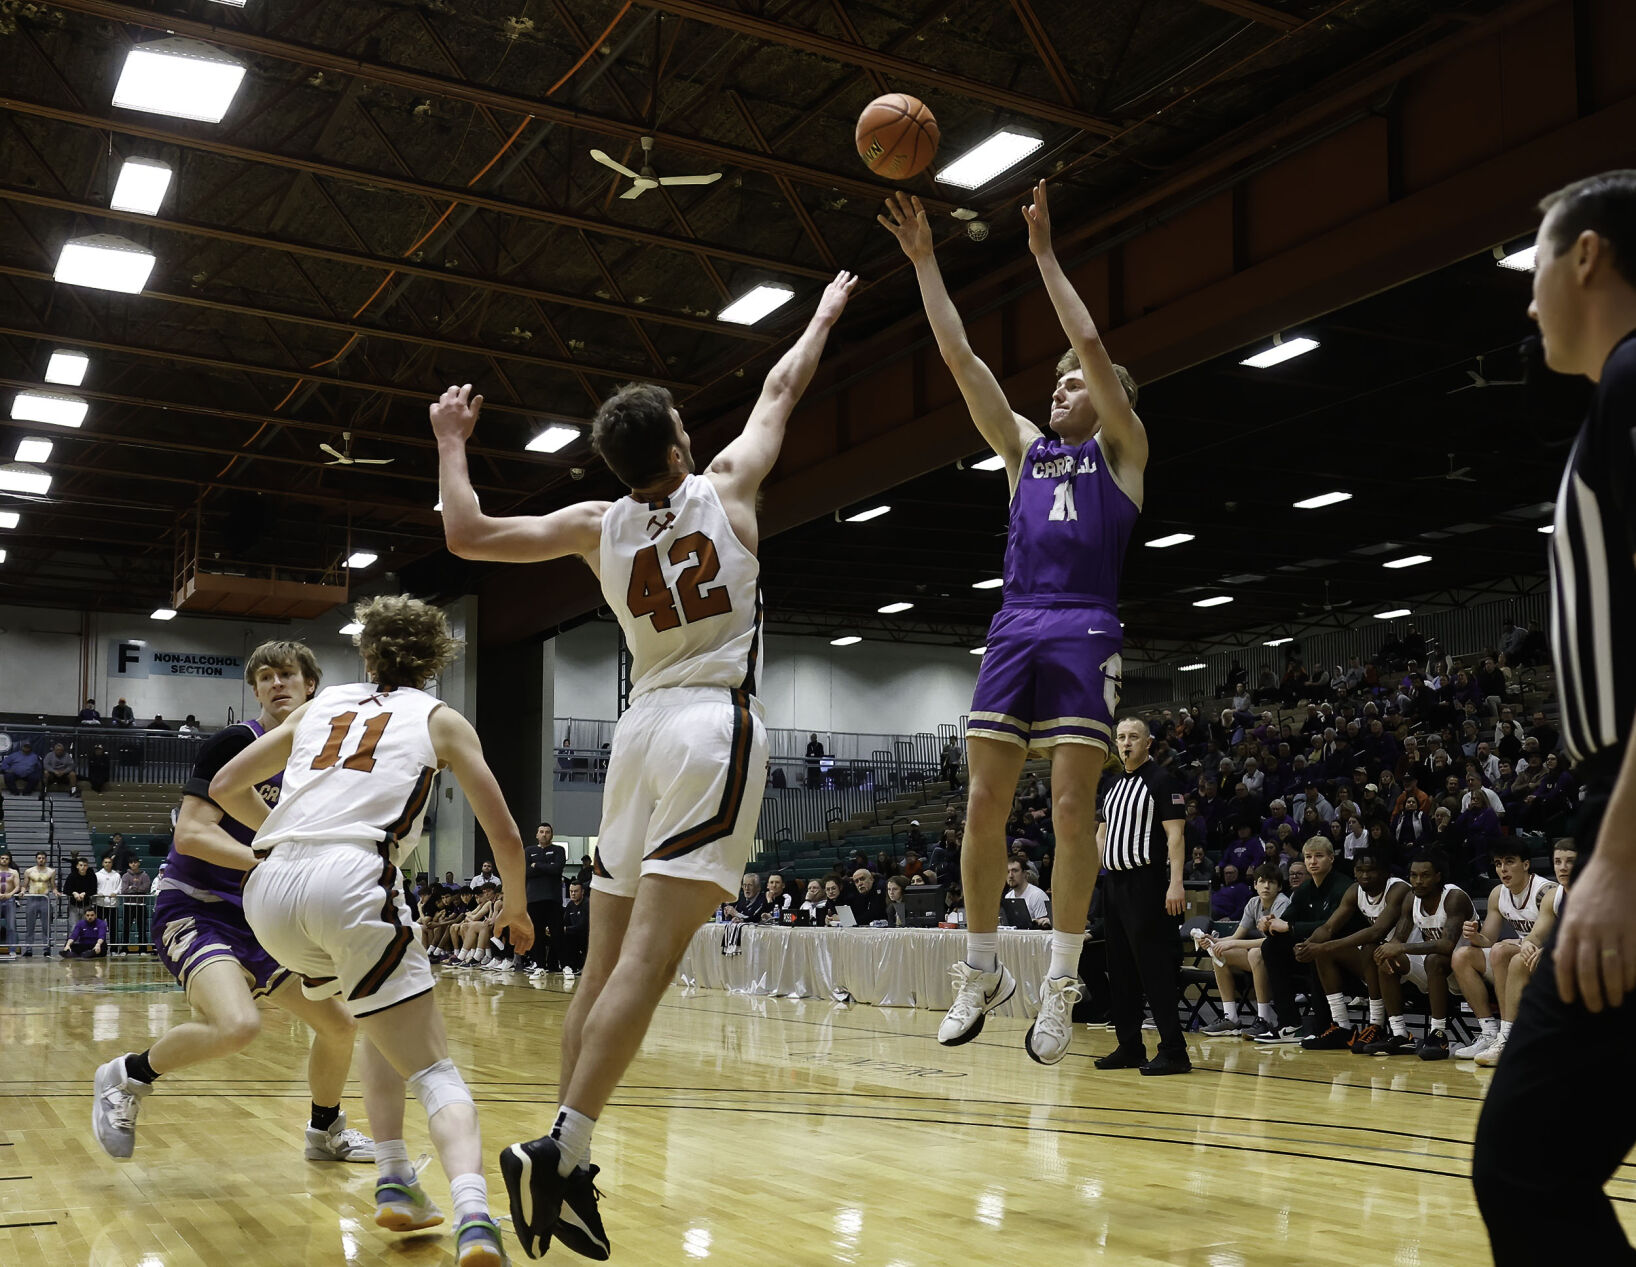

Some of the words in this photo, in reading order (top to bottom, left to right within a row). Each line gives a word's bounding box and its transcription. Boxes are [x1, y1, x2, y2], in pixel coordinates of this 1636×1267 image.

[1032, 455, 1097, 479] CARRLL
[627, 530, 732, 633] 42
[118, 644, 140, 673] F
[154, 652, 240, 667] NON-ALCOHOL
[171, 664, 222, 676] SECTION
[310, 710, 393, 773] 11
